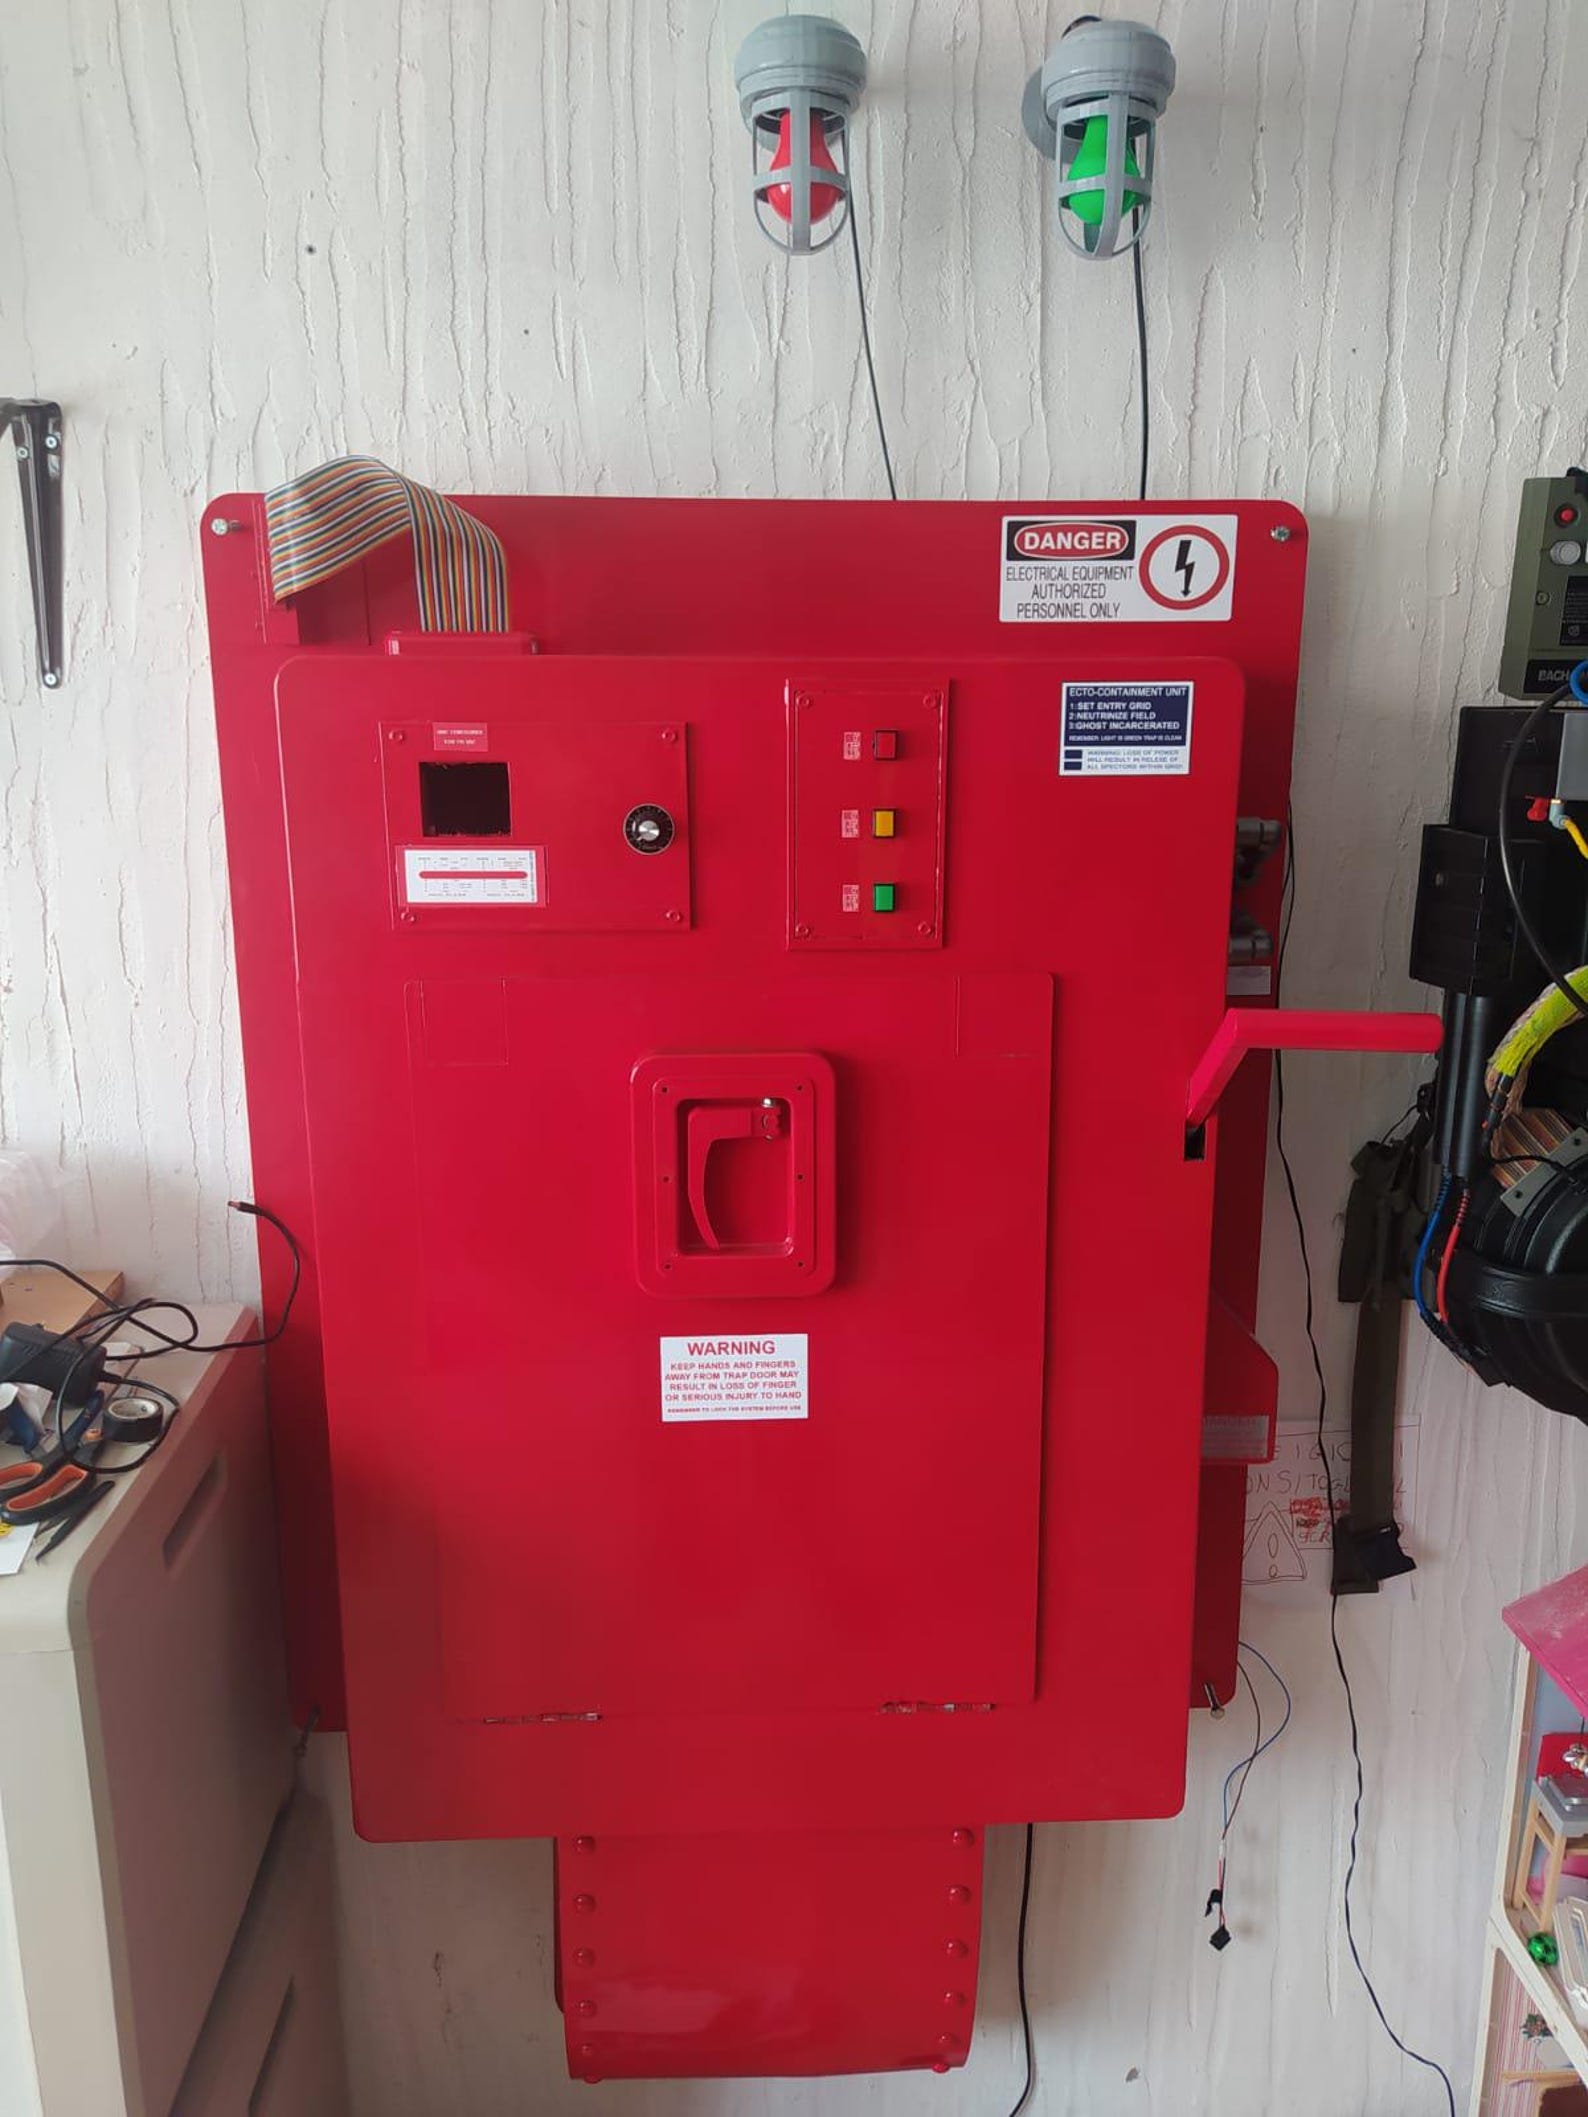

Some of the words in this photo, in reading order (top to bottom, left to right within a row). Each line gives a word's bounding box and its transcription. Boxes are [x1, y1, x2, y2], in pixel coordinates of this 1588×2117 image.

[1024, 532, 1121, 550] DANGER
[1006, 566, 1069, 581] ELECTRICAL
[1072, 566, 1134, 581] EQUIPMENT
[1031, 583, 1106, 599] AUTHORIZED
[1017, 603, 1087, 619] PERSONNEL
[1090, 603, 1120, 618] ONLY
[1069, 687, 1163, 697] ECTO-CONTAINMENT
[1166, 687, 1187, 696] UNIT
[1097, 702, 1128, 710] ENTRY
[1129, 701, 1152, 710] GRID
[1130, 711, 1156, 720] FIELD
[1109, 721, 1180, 730] INCARCERATED
[687, 1340, 776, 1357] WARNING
[670, 1362, 696, 1371] KEEP
[698, 1362, 730, 1370] HANDS
[734, 1361, 752, 1369] AND
[755, 1360, 796, 1369] FINGERS
[665, 1373, 690, 1381] AWAY
[693, 1372, 720, 1380] FROM
[724, 1372, 748, 1380] TRAP
[750, 1371, 777, 1379] DOOR
[670, 1383, 705, 1391] RESULT
[720, 1382, 744, 1390] LOSS
[762, 1381, 797, 1389] FINGER
[665, 1393, 679, 1402] OR
[682, 1393, 723, 1401] SERIOUS
[725, 1392, 758, 1400] INJURY
[761, 1392, 773, 1400] TO
[775, 1391, 802, 1400] HAND
